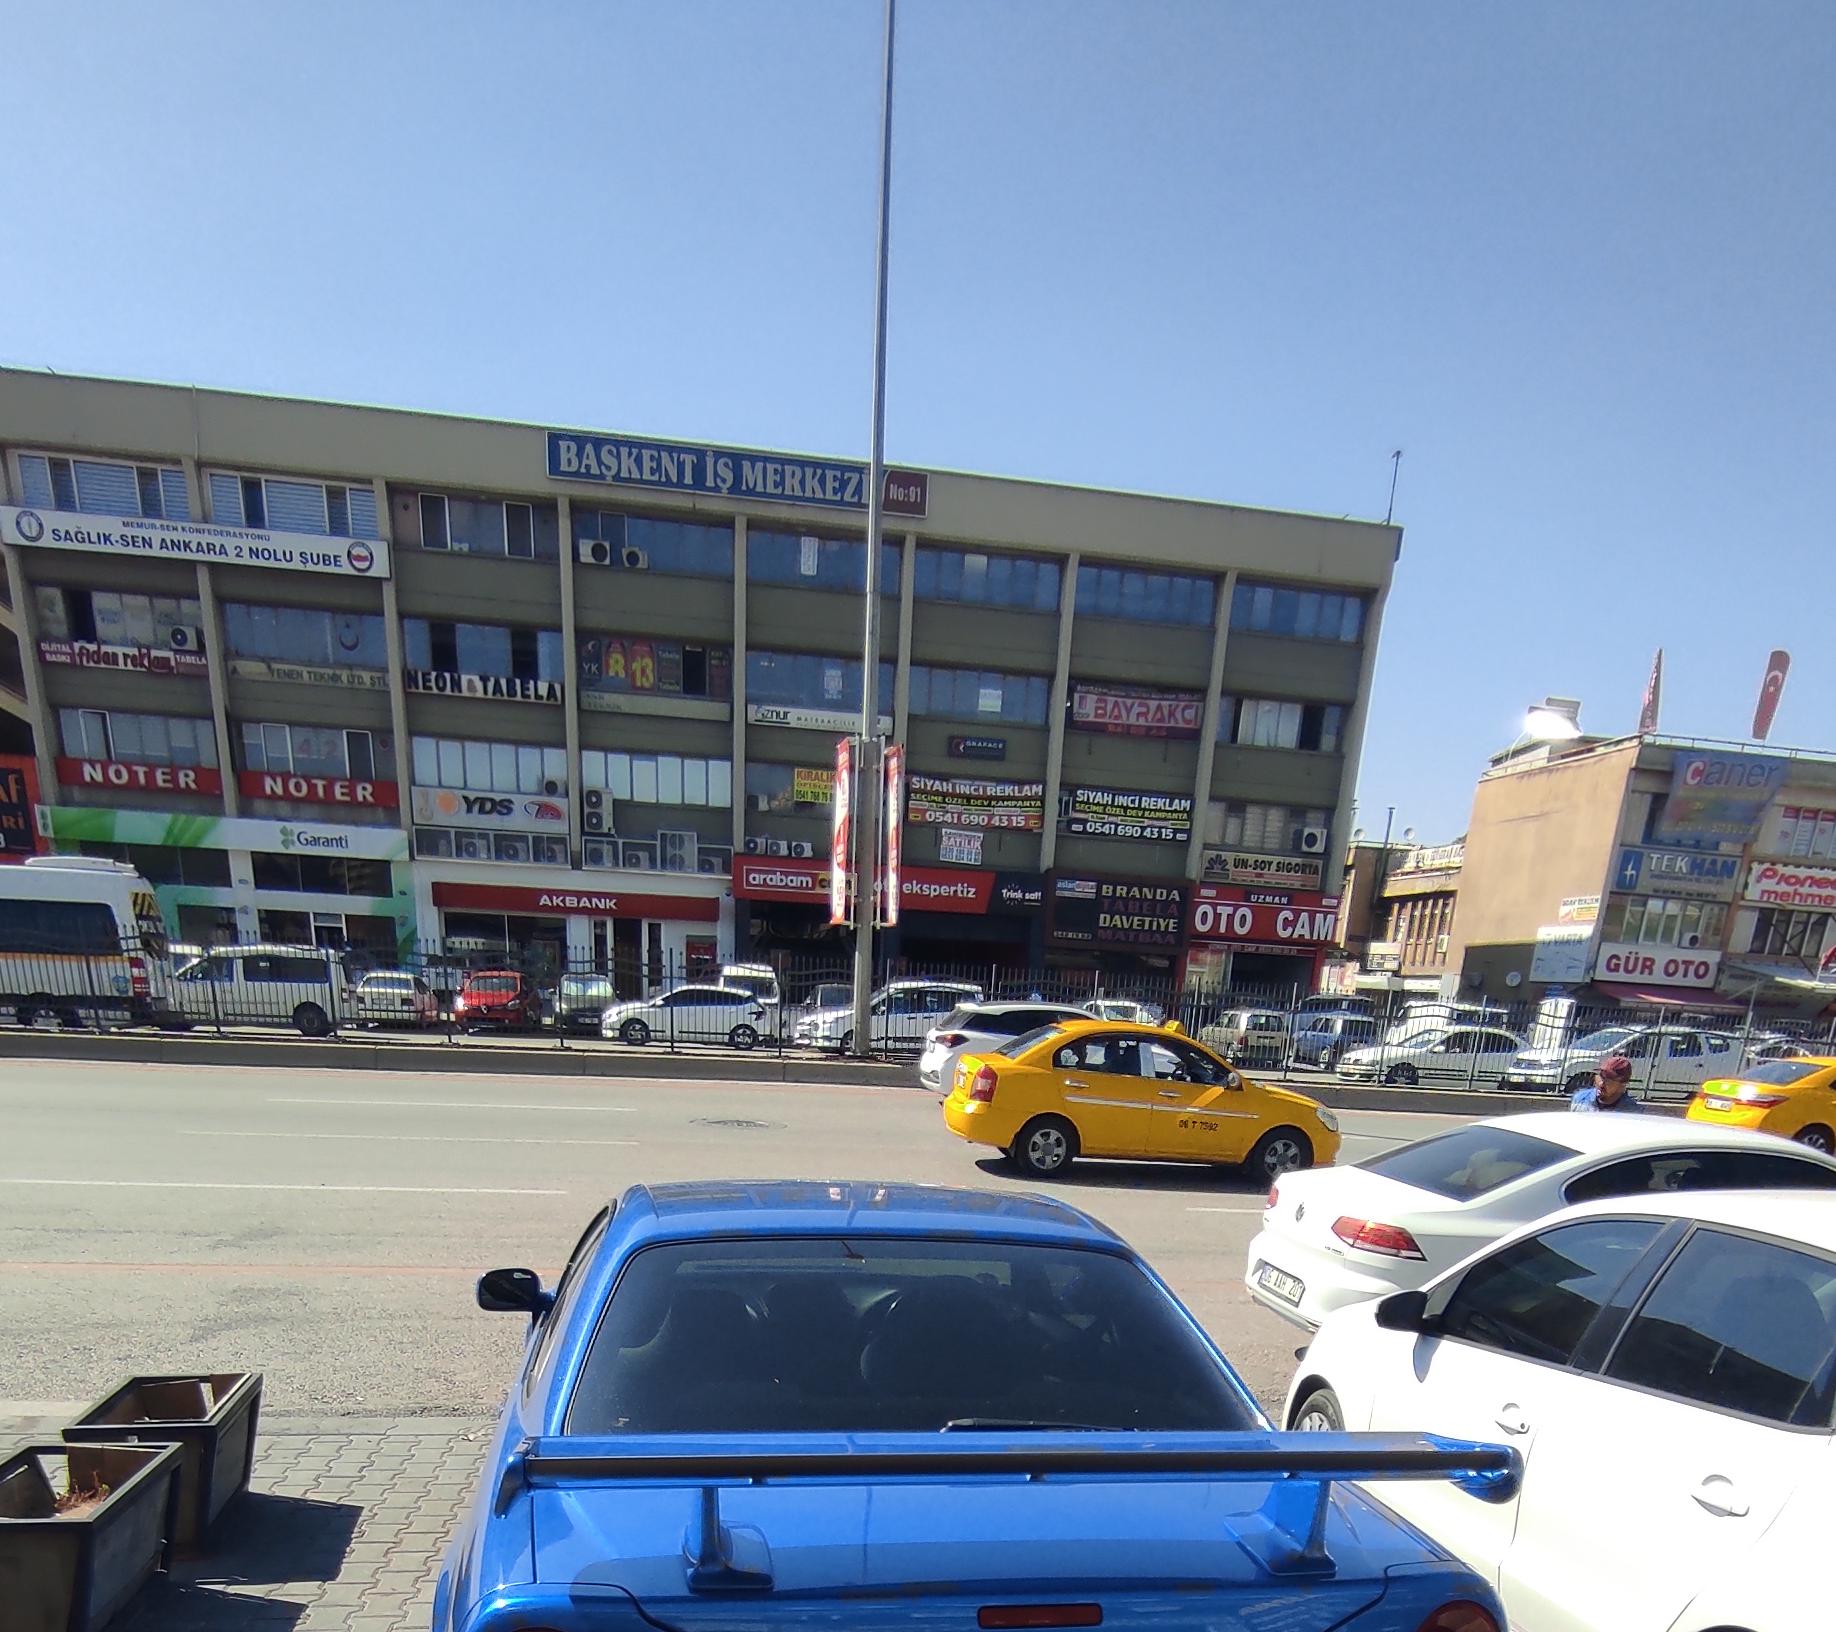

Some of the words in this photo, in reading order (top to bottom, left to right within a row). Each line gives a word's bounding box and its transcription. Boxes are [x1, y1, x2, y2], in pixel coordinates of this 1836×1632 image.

[559, 440, 697, 482] BAŞKENT
[705, 450, 734, 495] İŞ
[889, 484, 921, 503] No:91
[52, 525, 153, 549] SAĞLIK-SEN
[159, 538, 229, 557] ANKARA
[234, 545, 244, 558] 2
[249, 546, 294, 563] NOLU
[299, 551, 343, 568] ŞUBE
[406, 669, 463, 694] NEON
[479, 675, 558, 702] TABELA
[83, 761, 198, 790] NOTER
[264, 775, 375, 803] NOTER
[987, 783, 1043, 797] REKLAM
[462, 795, 516, 816] YDS
[970, 799, 989, 807] DEV
[991, 799, 1041, 808] KAMPANYA
[1141, 796, 1191, 812] REKLAM
[925, 811, 958, 824] 0541
[961, 814, 988, 827] 690
[991, 815, 1008, 828] 43
[1010, 816, 1026, 828] 15
[1127, 809, 1143, 817] DEV
[1144, 810, 1188, 820] KAMPANYA
[297, 831, 349, 849] Garanti
[1086, 822, 1115, 835] 0541
[1117, 825, 1141, 837] 690
[1143, 827, 1159, 839] 43
[1161, 828, 1174, 840] 15
[1233, 854, 1274, 872] ÜN-SOY
[1275, 859, 1320, 876] SİGORTA
[1649, 853, 1737, 879] TEKHAN
[749, 872, 812, 888] arabam
[902, 879, 976, 899] ekspertiz
[539, 894, 618, 910] AKBANK
[1102, 884, 1180, 902] BRANDA
[1250, 894, 1289, 905] UZMAN
[1102, 900, 1179, 916] TABELA
[1098, 913, 1179, 932] DAVETİYE
[1194, 904, 1253, 935] OTO
[1276, 910, 1336, 941] CAM
[1605, 951, 1656, 976] GÜR
[1663, 958, 1711, 980] OTO
